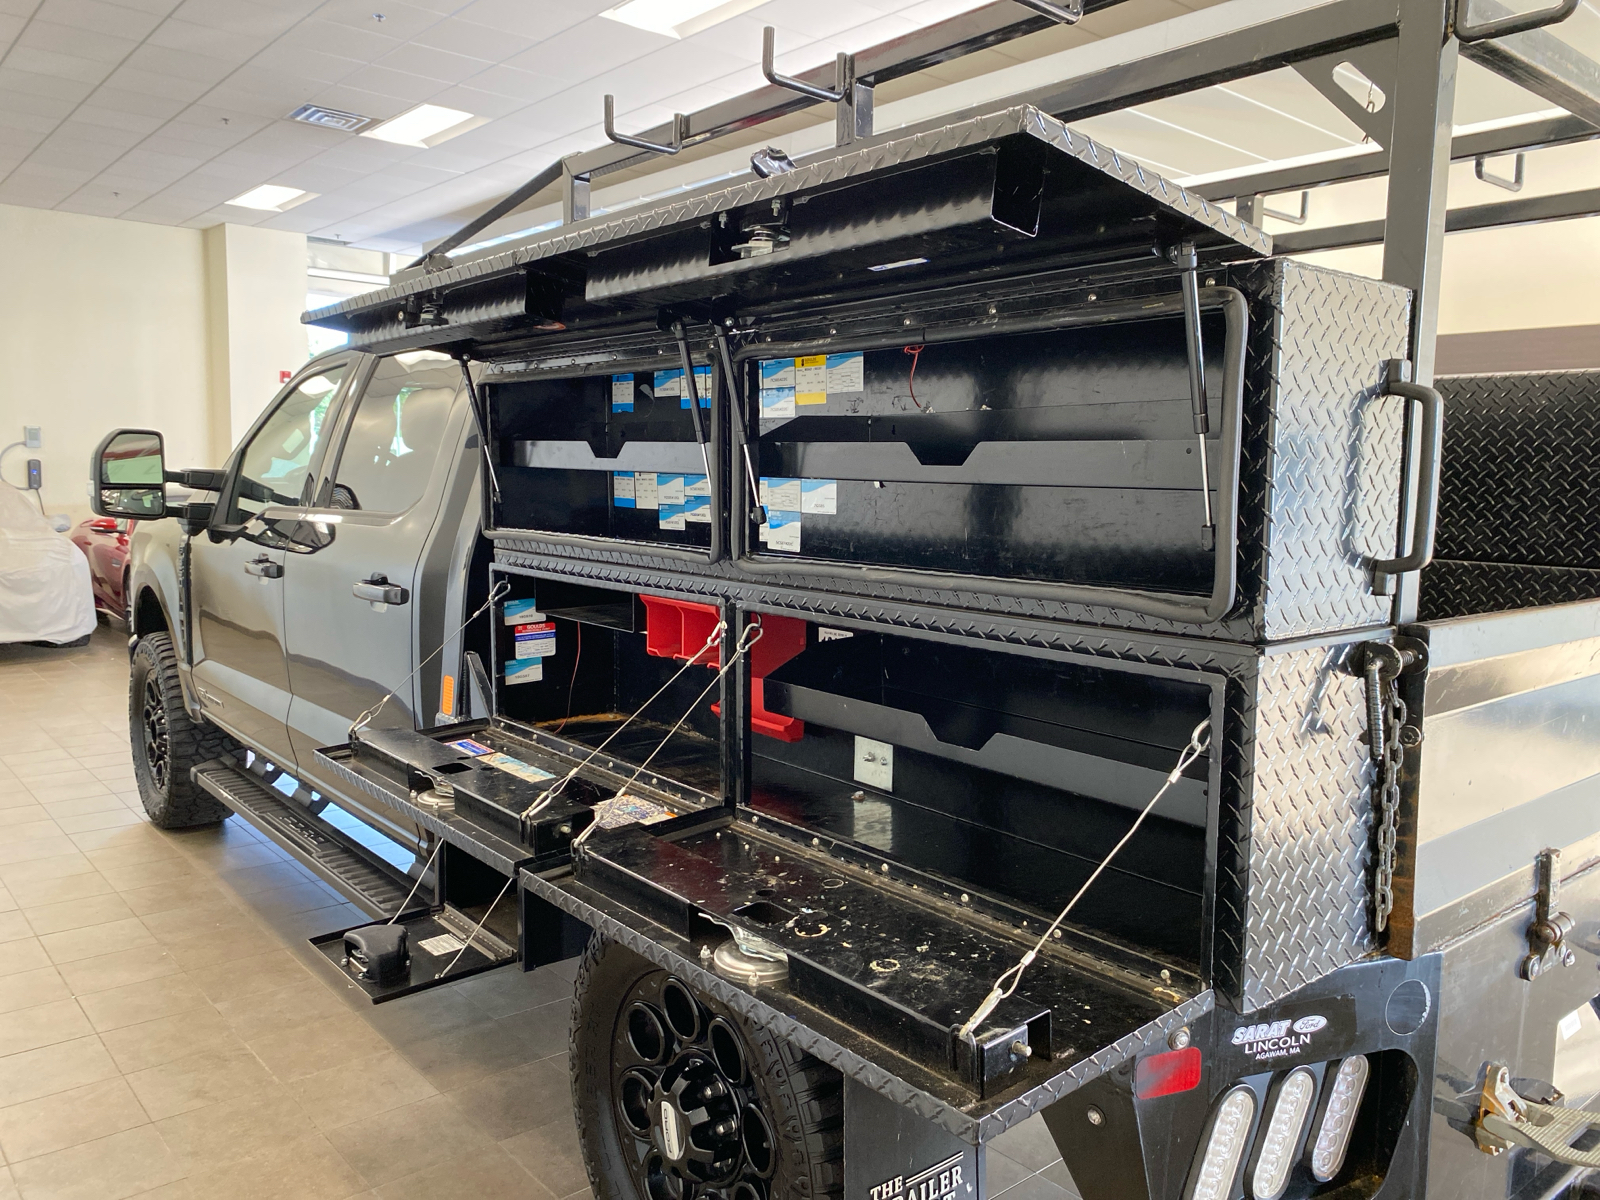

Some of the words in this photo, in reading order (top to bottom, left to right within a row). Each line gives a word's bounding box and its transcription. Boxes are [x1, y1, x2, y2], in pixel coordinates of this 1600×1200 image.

[1231, 1019, 1292, 1044] SARAT
[1244, 1033, 1311, 1054] LINCOLN
[1255, 1048, 1288, 1060] AGAWAM,
[1289, 1046, 1301, 1055] MA
[869, 1175, 903, 1200] THE
[891, 1165, 964, 1200] AILER
